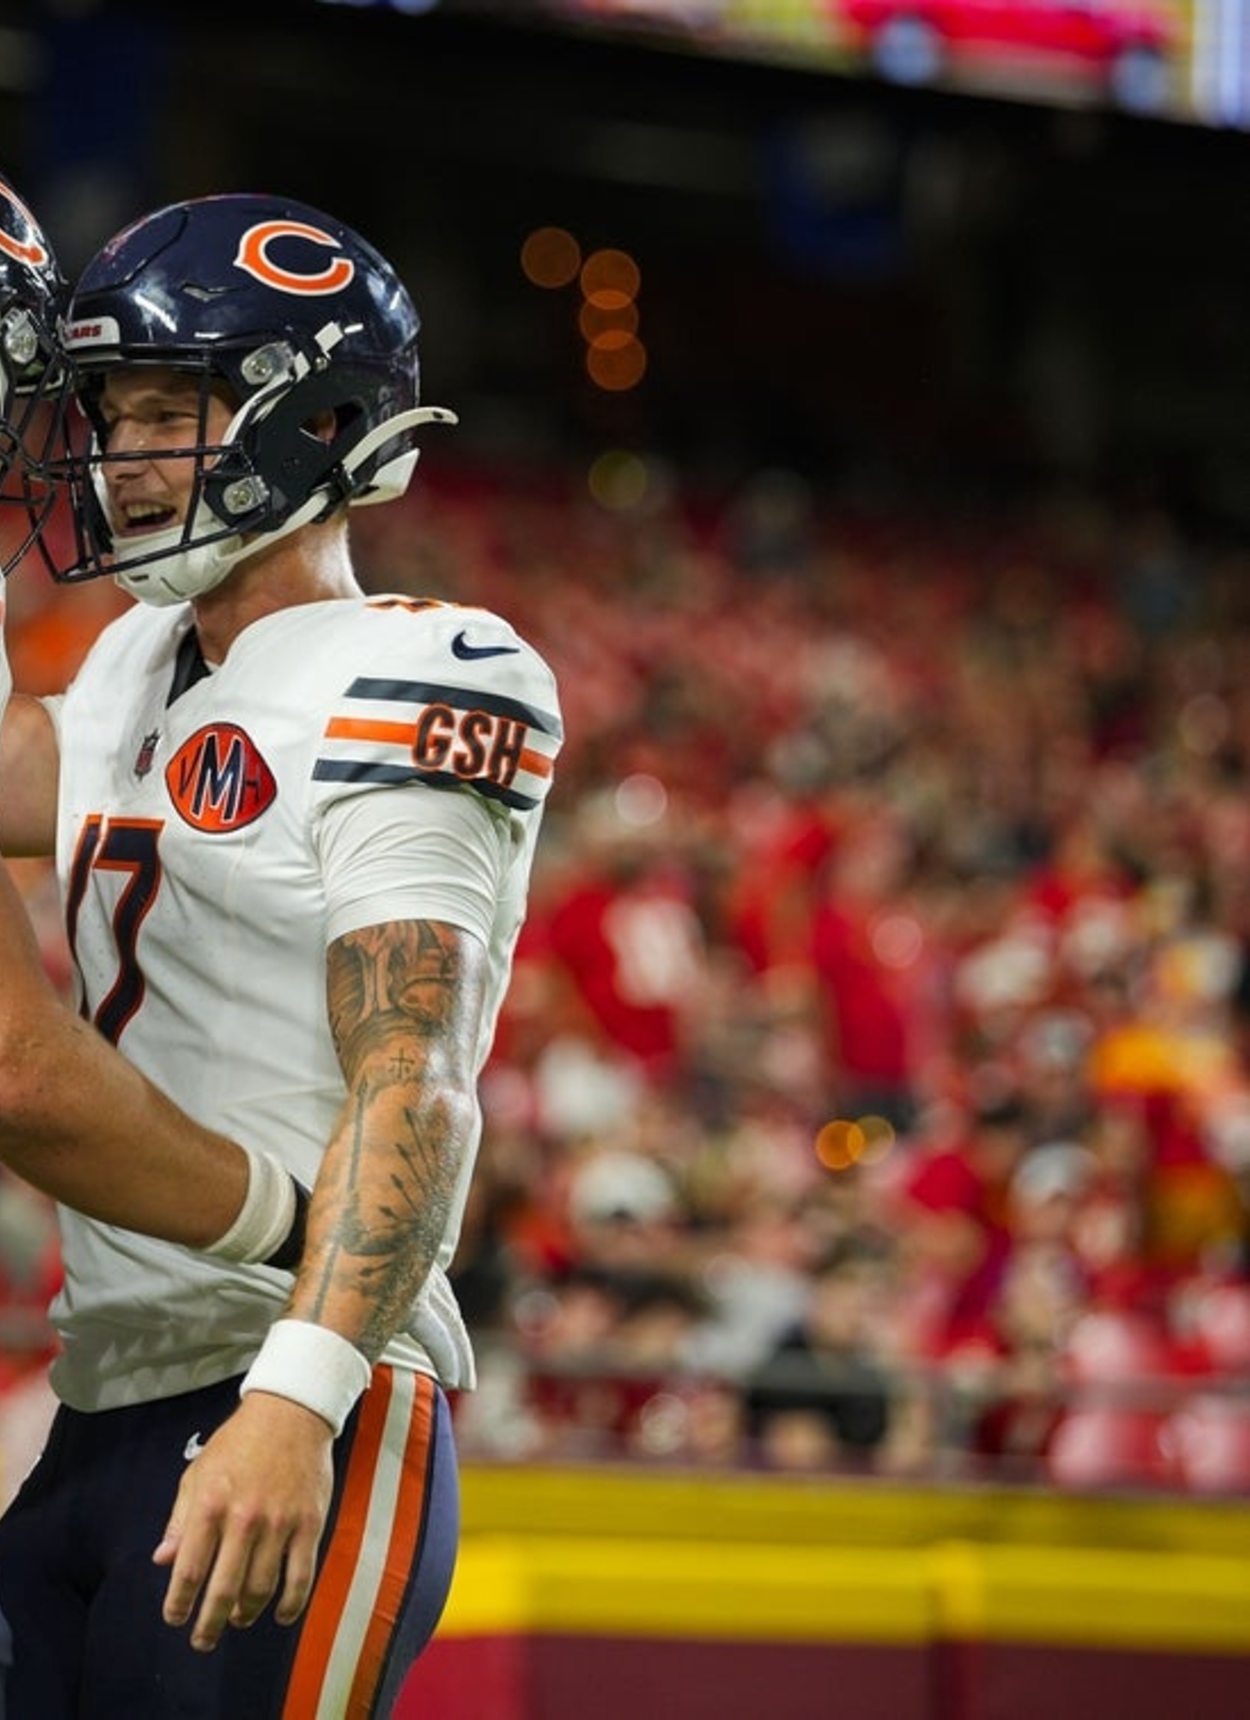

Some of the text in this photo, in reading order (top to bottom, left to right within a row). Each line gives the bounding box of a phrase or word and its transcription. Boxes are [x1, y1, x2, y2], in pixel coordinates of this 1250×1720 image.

[226, 220, 355, 297] C
[62, 324, 102, 340] ARS
[410, 702, 528, 790] GSH
[66, 813, 166, 1049] 17
